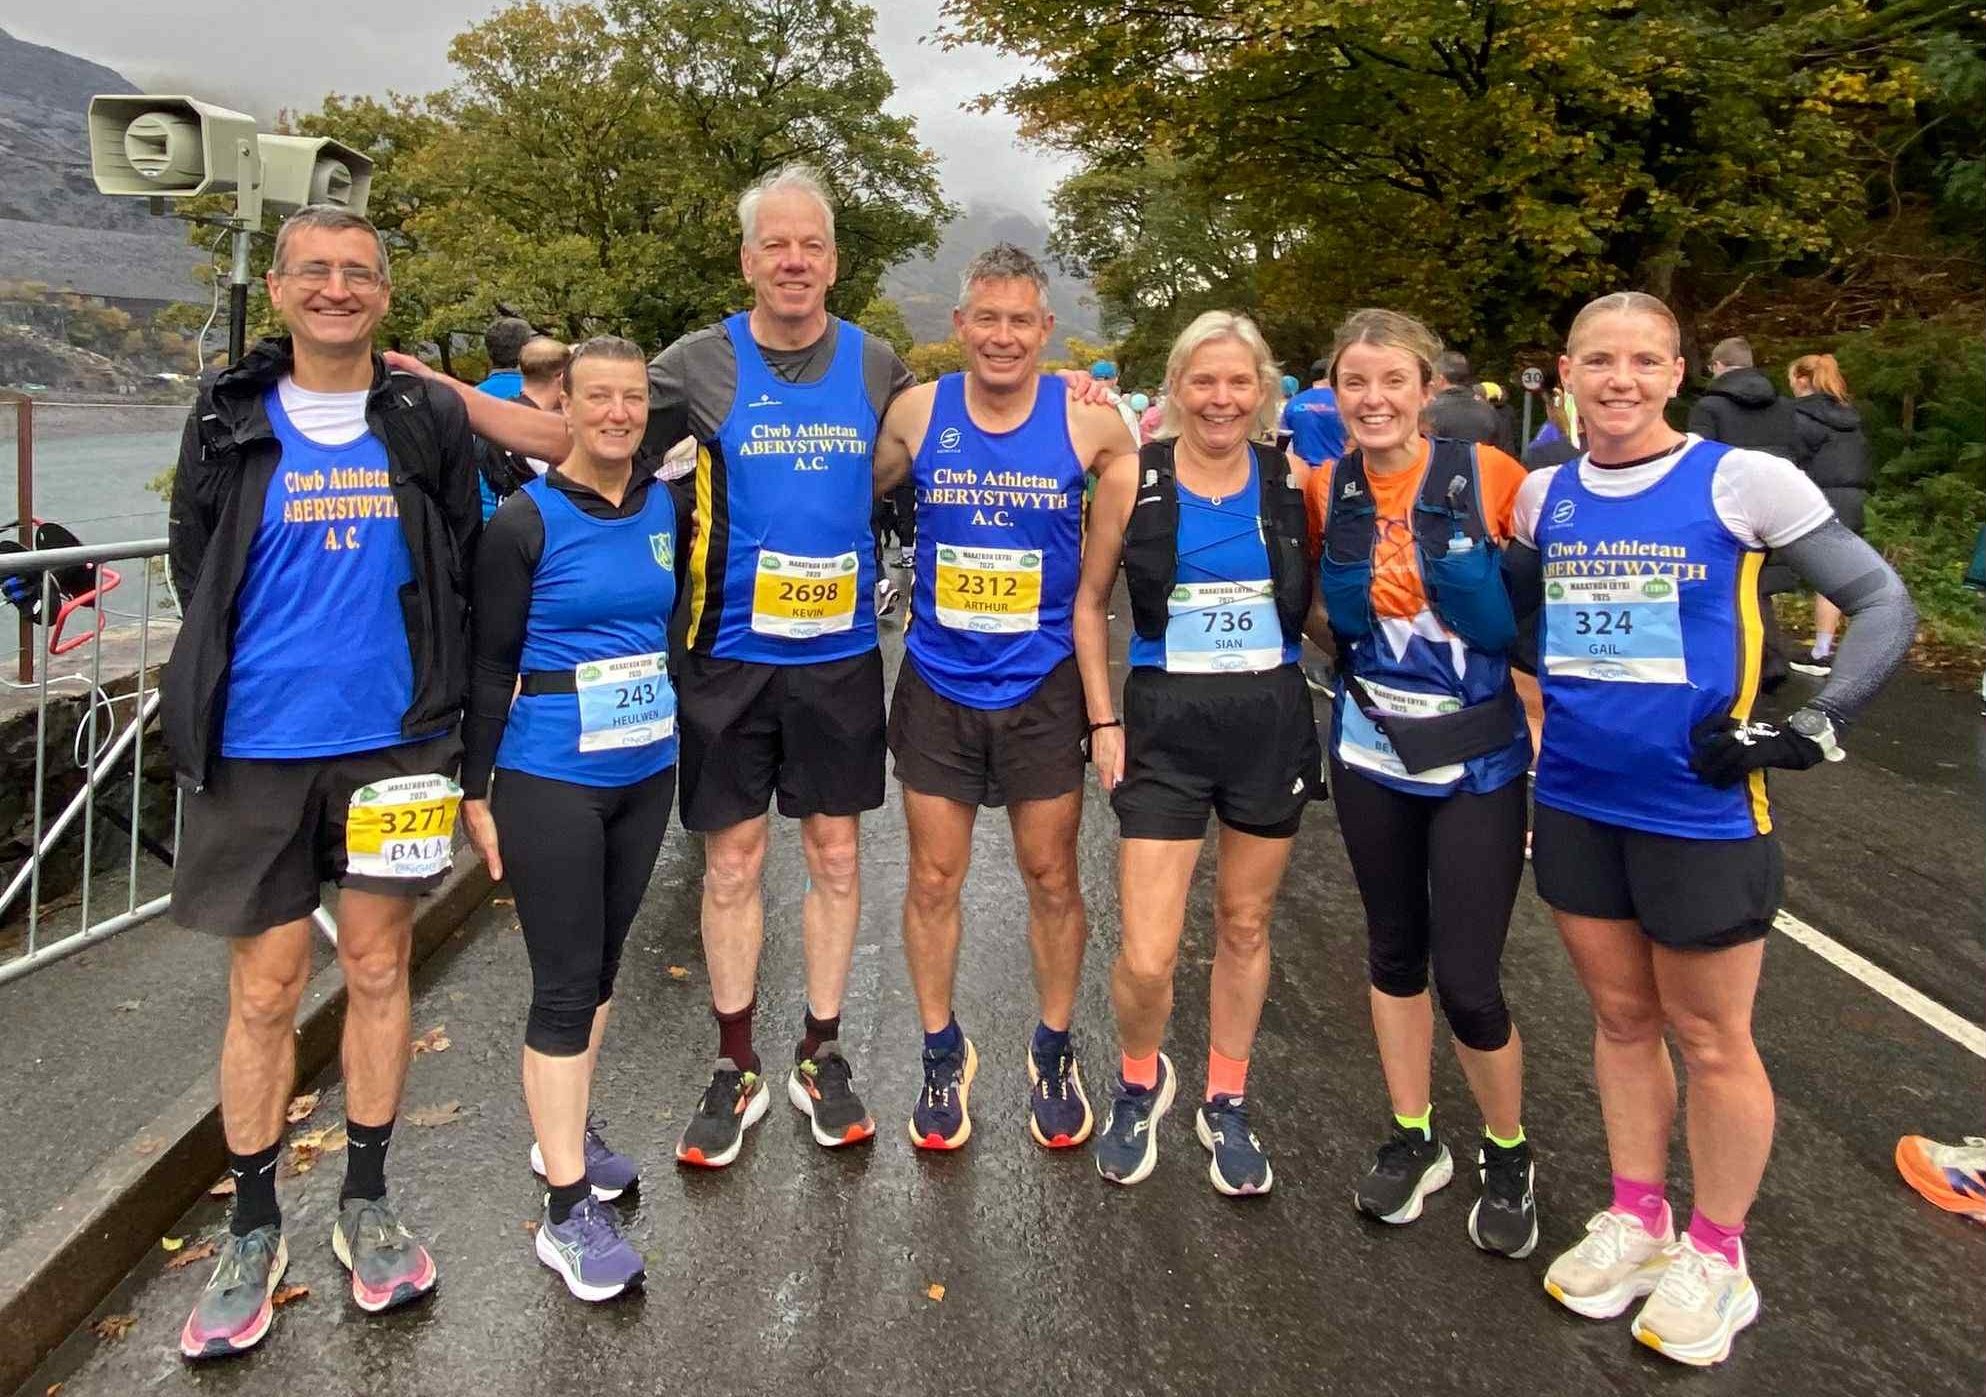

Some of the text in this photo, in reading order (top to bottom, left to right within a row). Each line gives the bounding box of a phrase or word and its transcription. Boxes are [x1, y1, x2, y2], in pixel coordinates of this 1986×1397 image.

[1523, 372, 1543, 384] 30
[750, 422, 858, 439] Clwb Athletau
[739, 439, 867, 456] ABERYSTWYTH
[793, 456, 829, 471] A.C.
[284, 469, 325, 493] Clwb
[933, 468, 1059, 490] Clwb Athletau
[924, 488, 1069, 510] ABERYSTWYTH
[971, 509, 1015, 527] A.C.
[1548, 540, 1687, 558] Clwb Athletau
[778, 582, 838, 603] 2698
[957, 574, 1017, 596] 2312
[792, 607, 824, 618] KEVIN
[964, 600, 1009, 612] ARTHUR
[1202, 611, 1254, 632] 736
[1575, 610, 1633, 635] 324
[1215, 639, 1243, 649] SIAN
[1588, 644, 1621, 655] GAIL
[615, 683, 656, 709] 243
[612, 709, 659, 728] HEULWEN
[1375, 740, 1394, 754] BE
[380, 805, 445, 834] 3277
[391, 839, 443, 861] BALA
